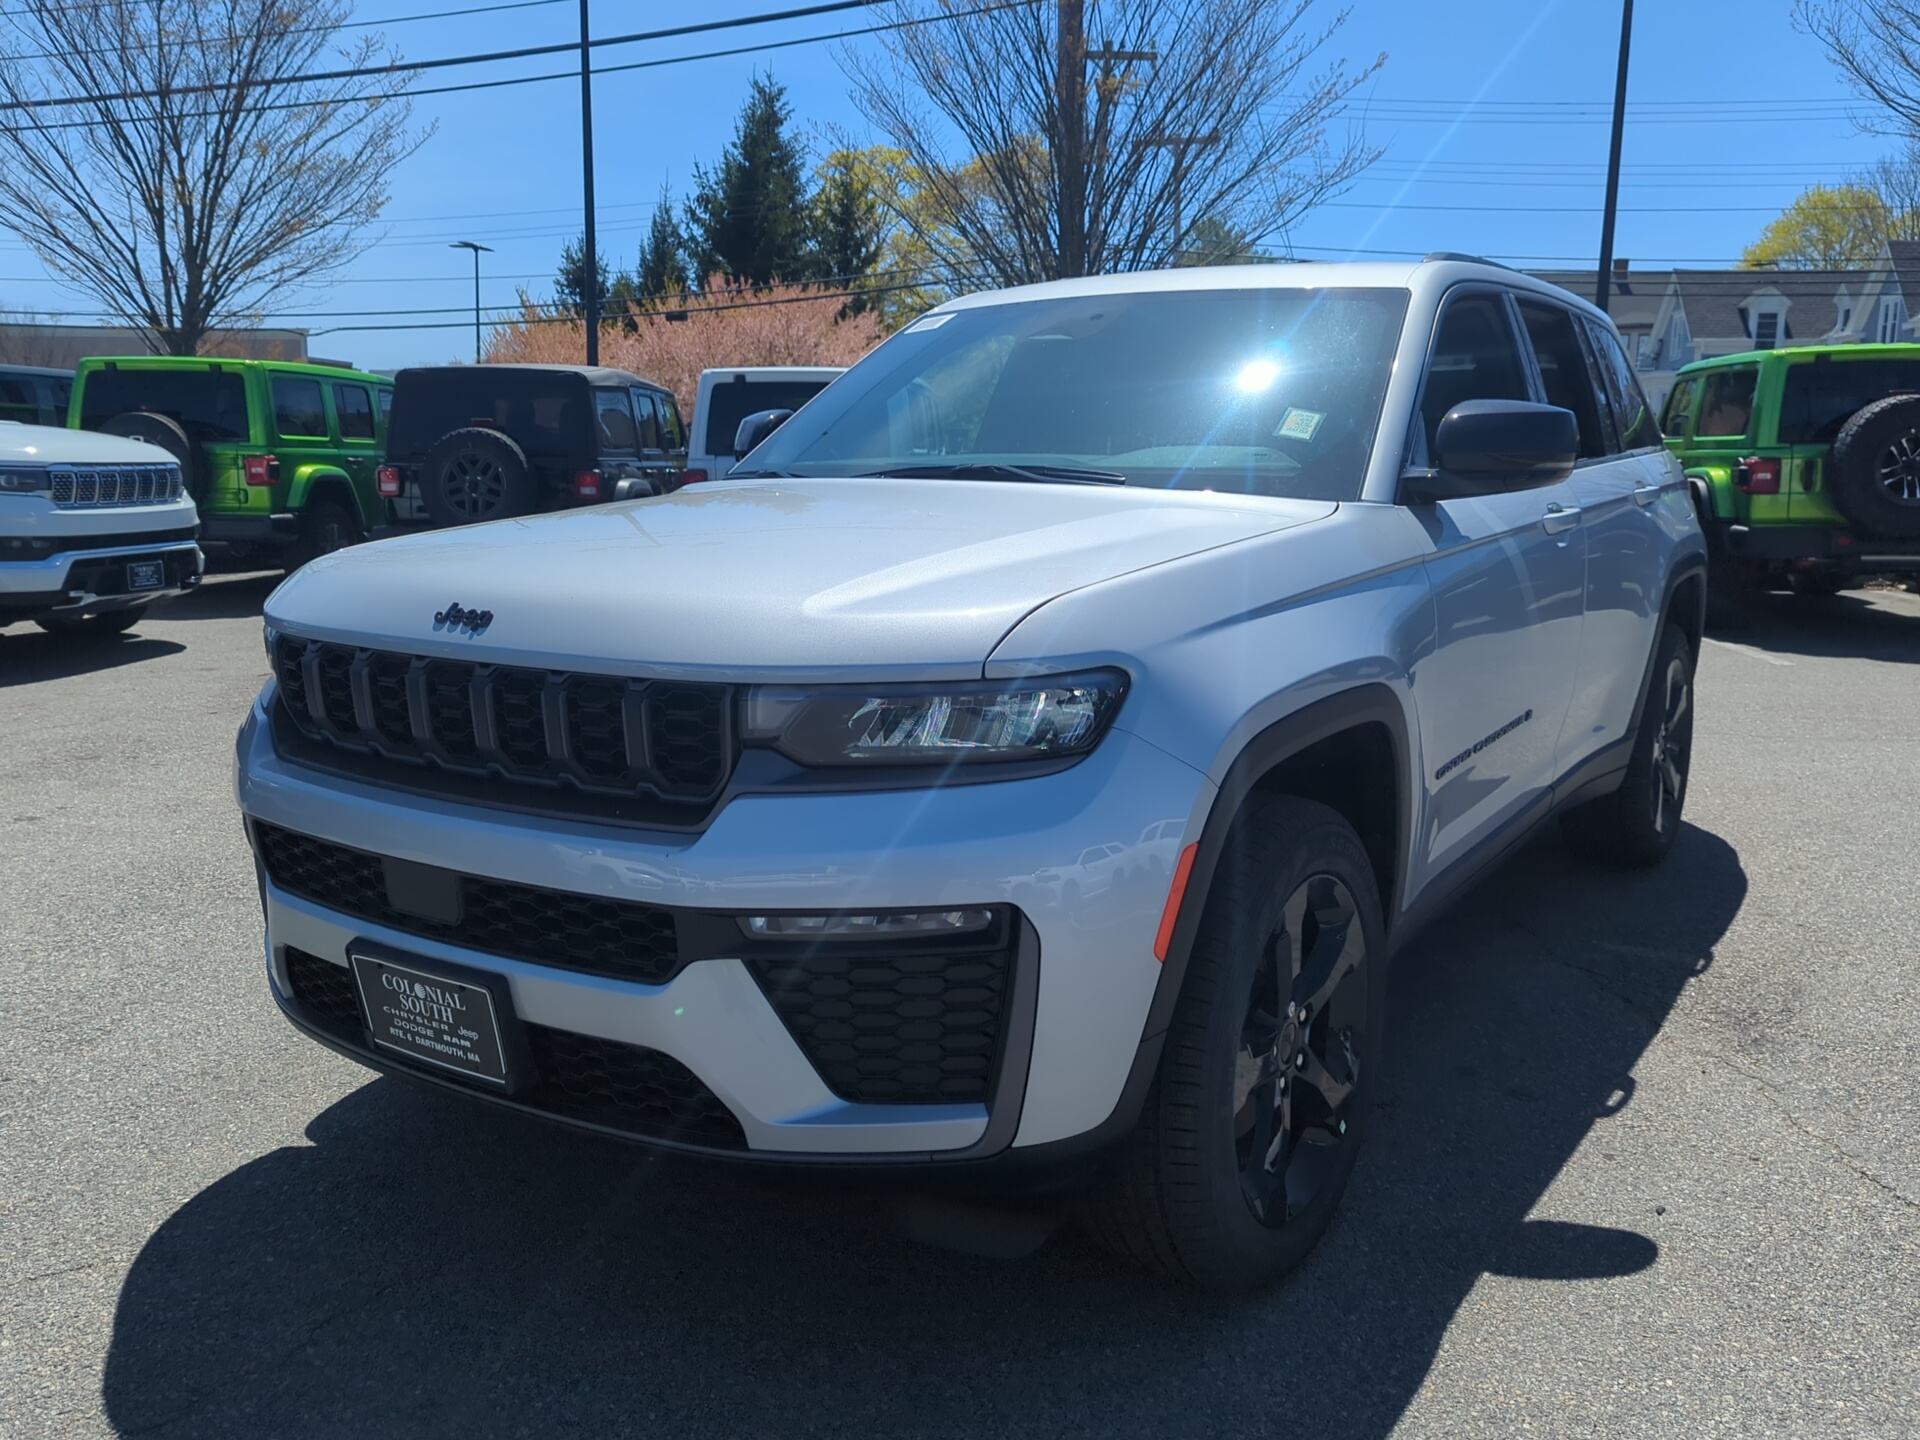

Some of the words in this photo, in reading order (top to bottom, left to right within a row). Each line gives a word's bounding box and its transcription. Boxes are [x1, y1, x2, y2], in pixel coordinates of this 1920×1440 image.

[434, 602, 494, 632] Jeep
[383, 1005, 449, 1032] CHRYSLER
[399, 993, 454, 1024] SOUTH
[393, 1018, 435, 1038] DODGE
[443, 1034, 471, 1048] RAM
[457, 1026, 479, 1041] Jeep
[389, 1026, 406, 1040] RTE.
[467, 1051, 480, 1063] MA
